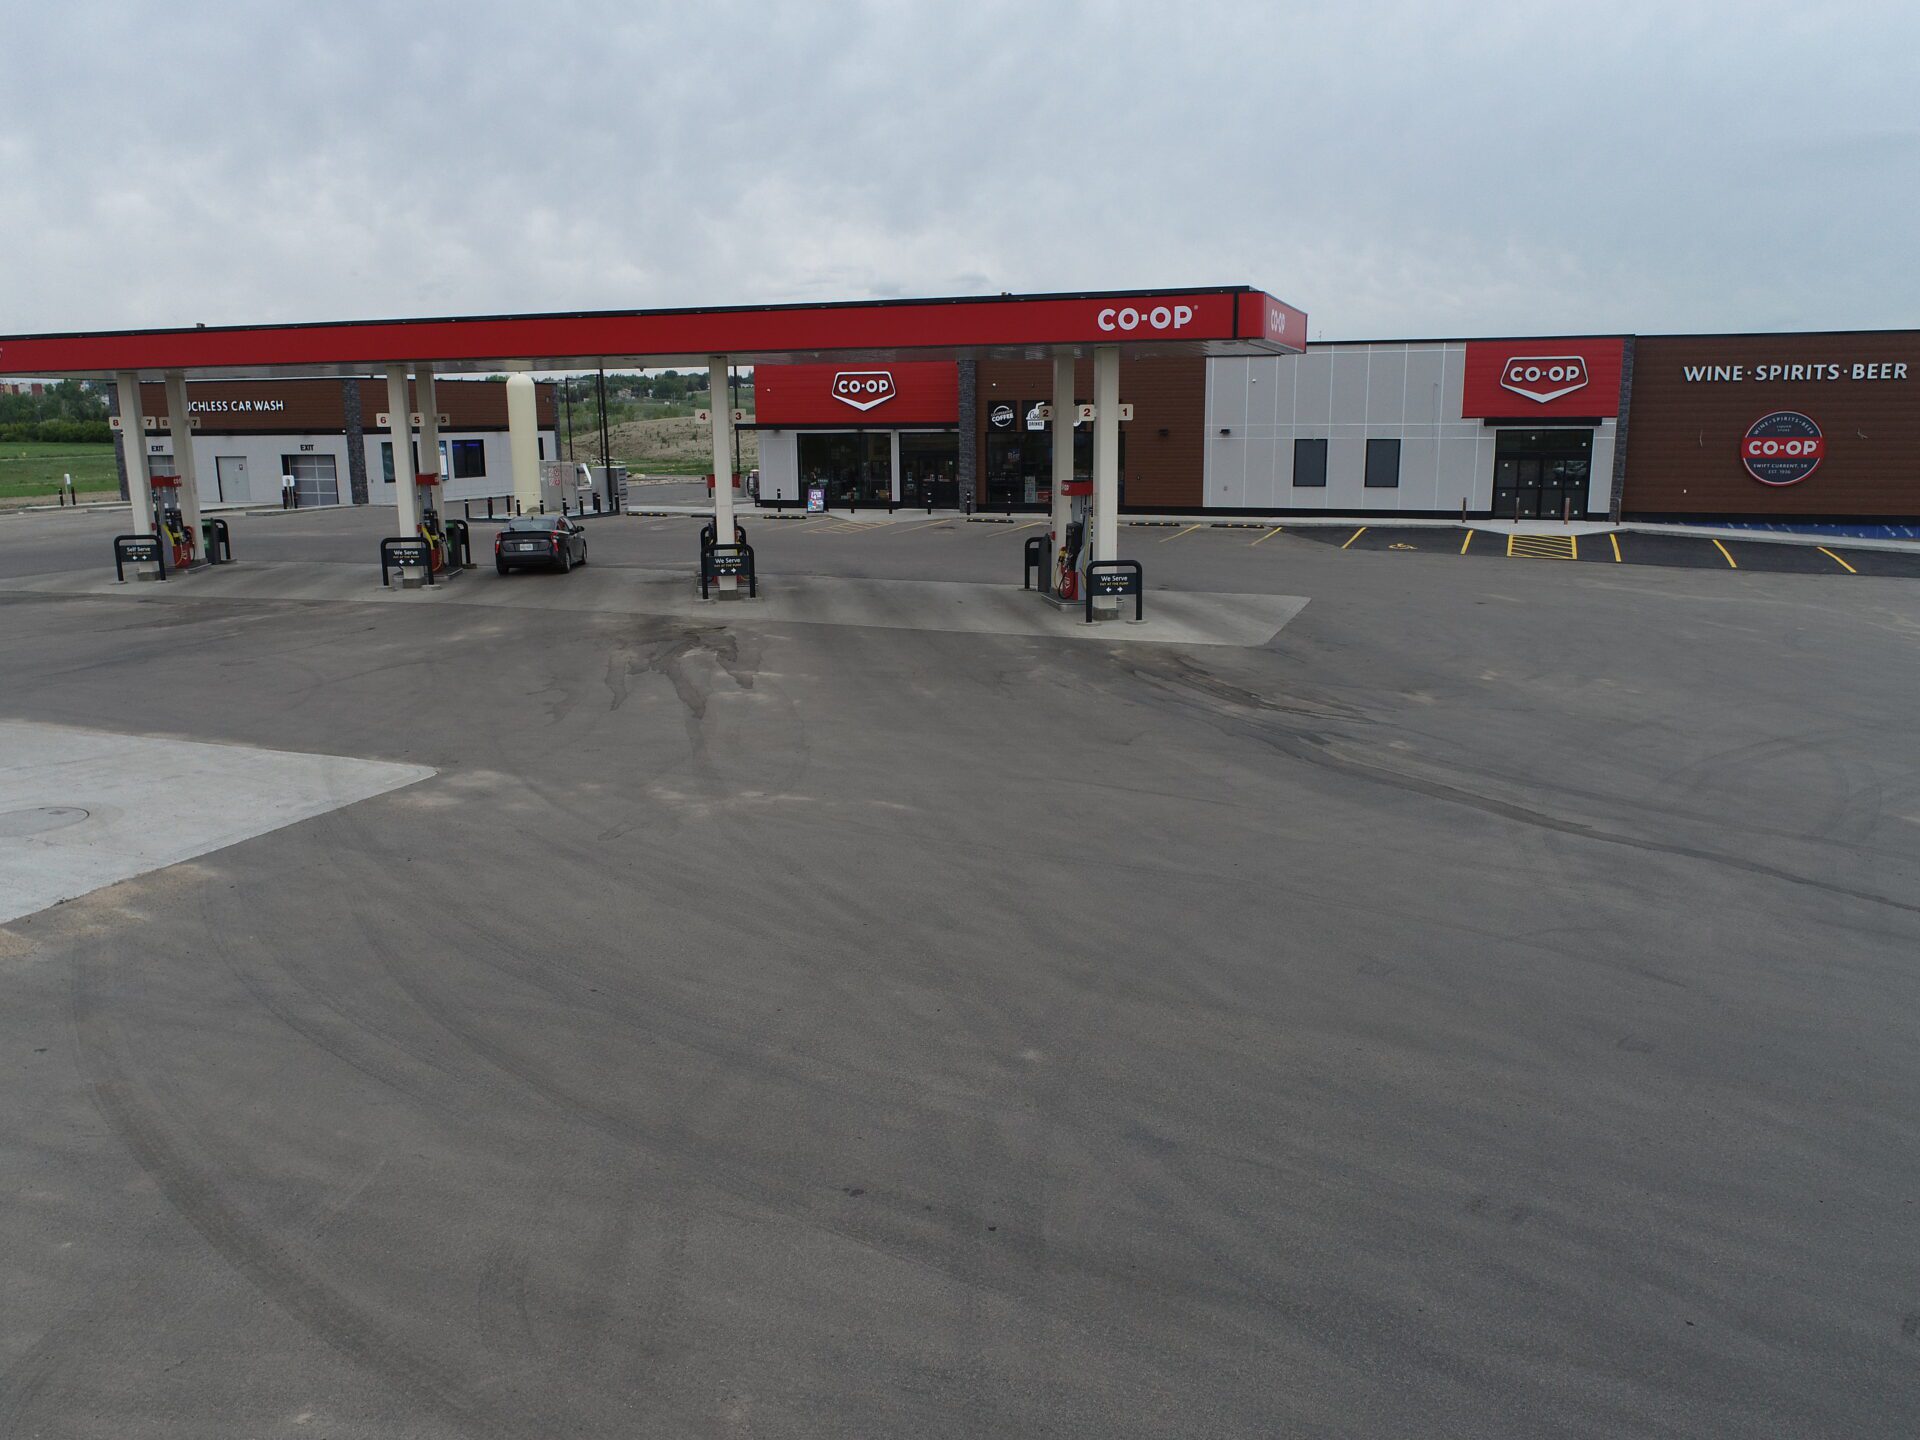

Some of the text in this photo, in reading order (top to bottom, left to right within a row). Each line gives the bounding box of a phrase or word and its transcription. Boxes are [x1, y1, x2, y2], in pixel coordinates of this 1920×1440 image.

[1683, 363, 1908, 382] WINE SPIRITS BEER
[231, 401, 252, 411] CAR
[253, 400, 284, 411] WASH
[699, 412, 706, 420] 4
[735, 412, 742, 420] 3
[1042, 409, 1049, 417] 2
[1083, 408, 1091, 417] 2
[1122, 408, 1128, 416] 1
[380, 416, 387, 424] 6
[414, 416, 420, 424] 5
[991, 412, 1014, 422] COFFEE
